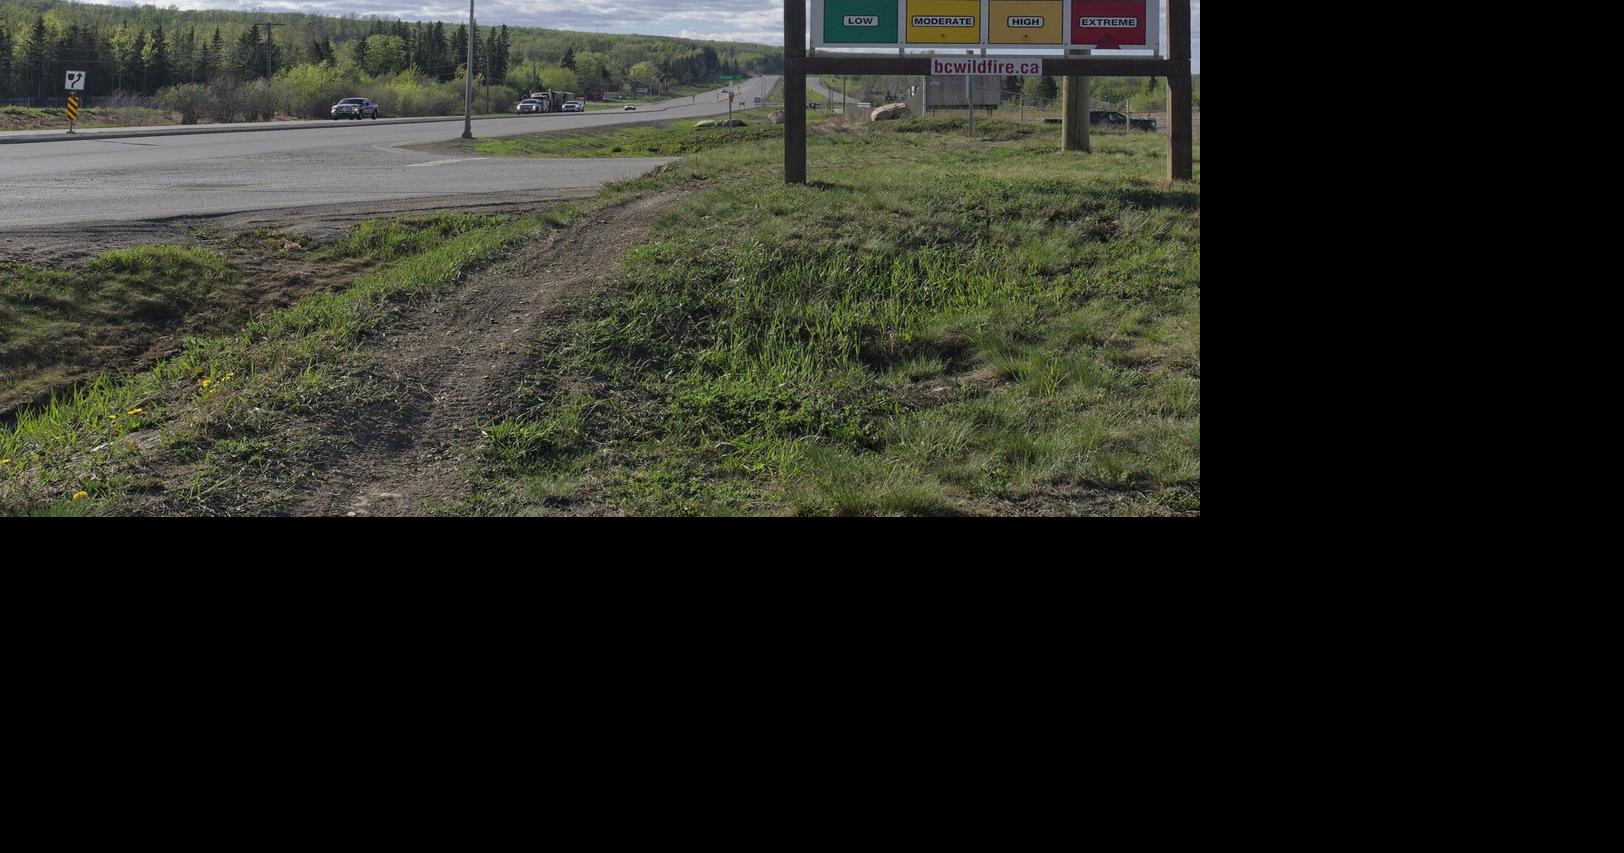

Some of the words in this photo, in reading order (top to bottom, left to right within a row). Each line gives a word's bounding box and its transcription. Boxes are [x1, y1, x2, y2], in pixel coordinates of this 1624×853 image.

[848, 17, 874, 25] LOW
[914, 17, 973, 25] MODERATE
[1012, 18, 1039, 26] HIGH
[1081, 18, 1136, 26] EXTREME
[934, 59, 1040, 74] bcwildfire.ca
